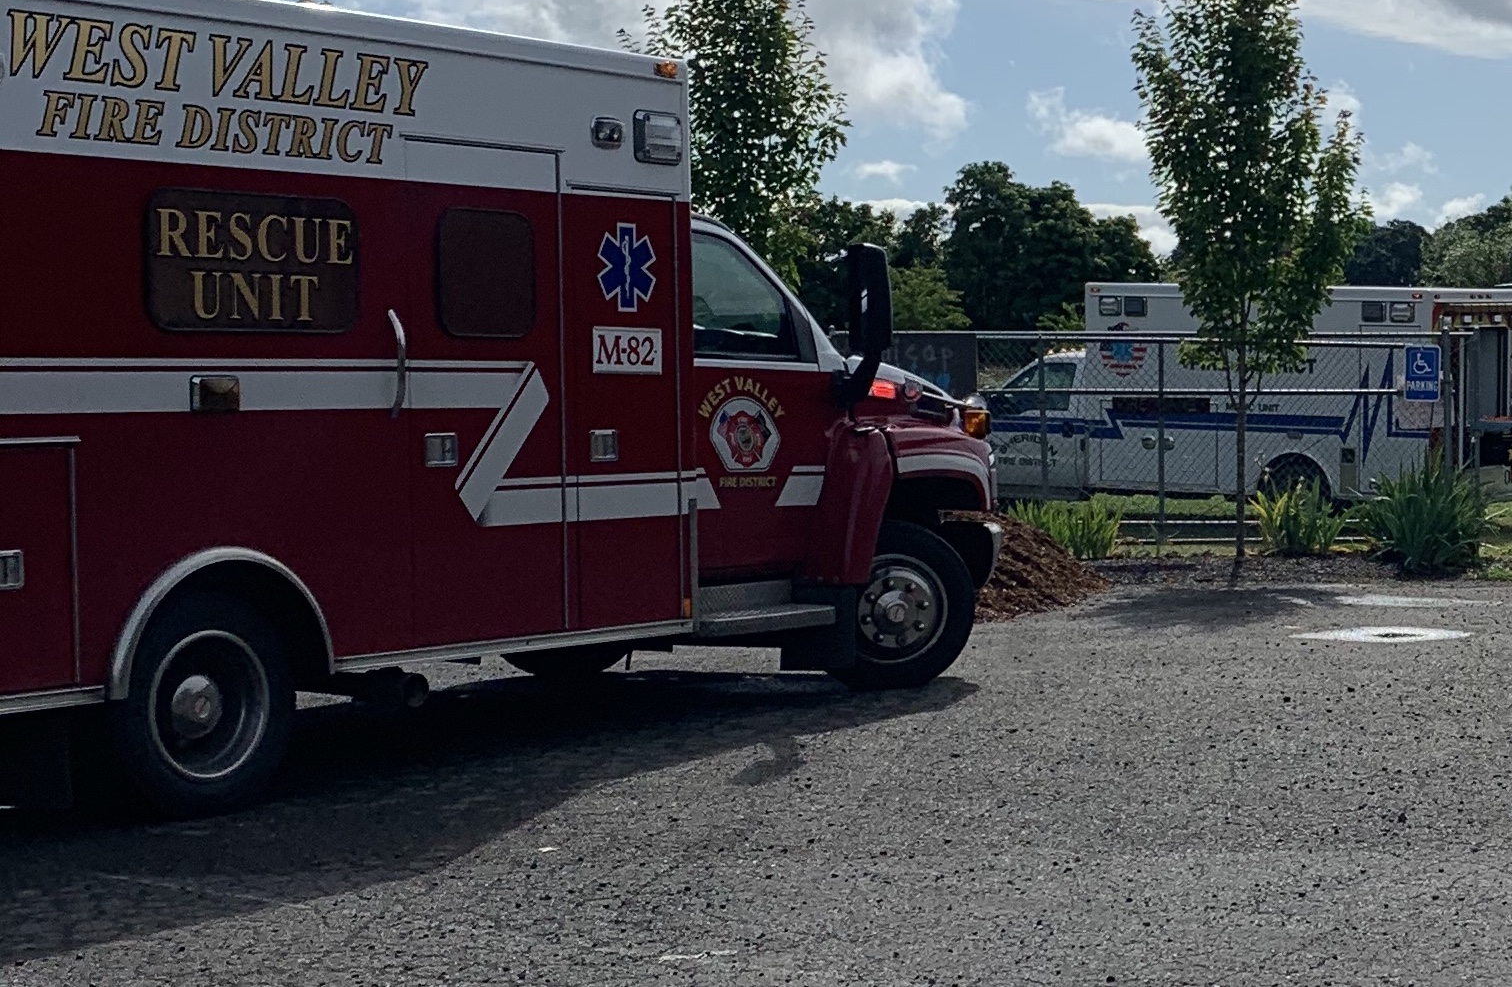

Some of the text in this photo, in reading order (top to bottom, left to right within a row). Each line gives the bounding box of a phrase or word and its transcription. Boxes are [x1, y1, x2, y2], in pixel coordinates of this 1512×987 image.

[7, 9, 429, 117] WEST VALLEY
[36, 90, 393, 165] FIRE DISTRICT
[155, 207, 354, 265] RESCUE
[188, 270, 320, 321] UNIT
[595, 334, 655, 366] M-82
[697, 375, 786, 419] WEST VALLEY
[1406, 380, 1438, 392] PARKING
[719, 476, 777, 488] FIRE DISTRICT
